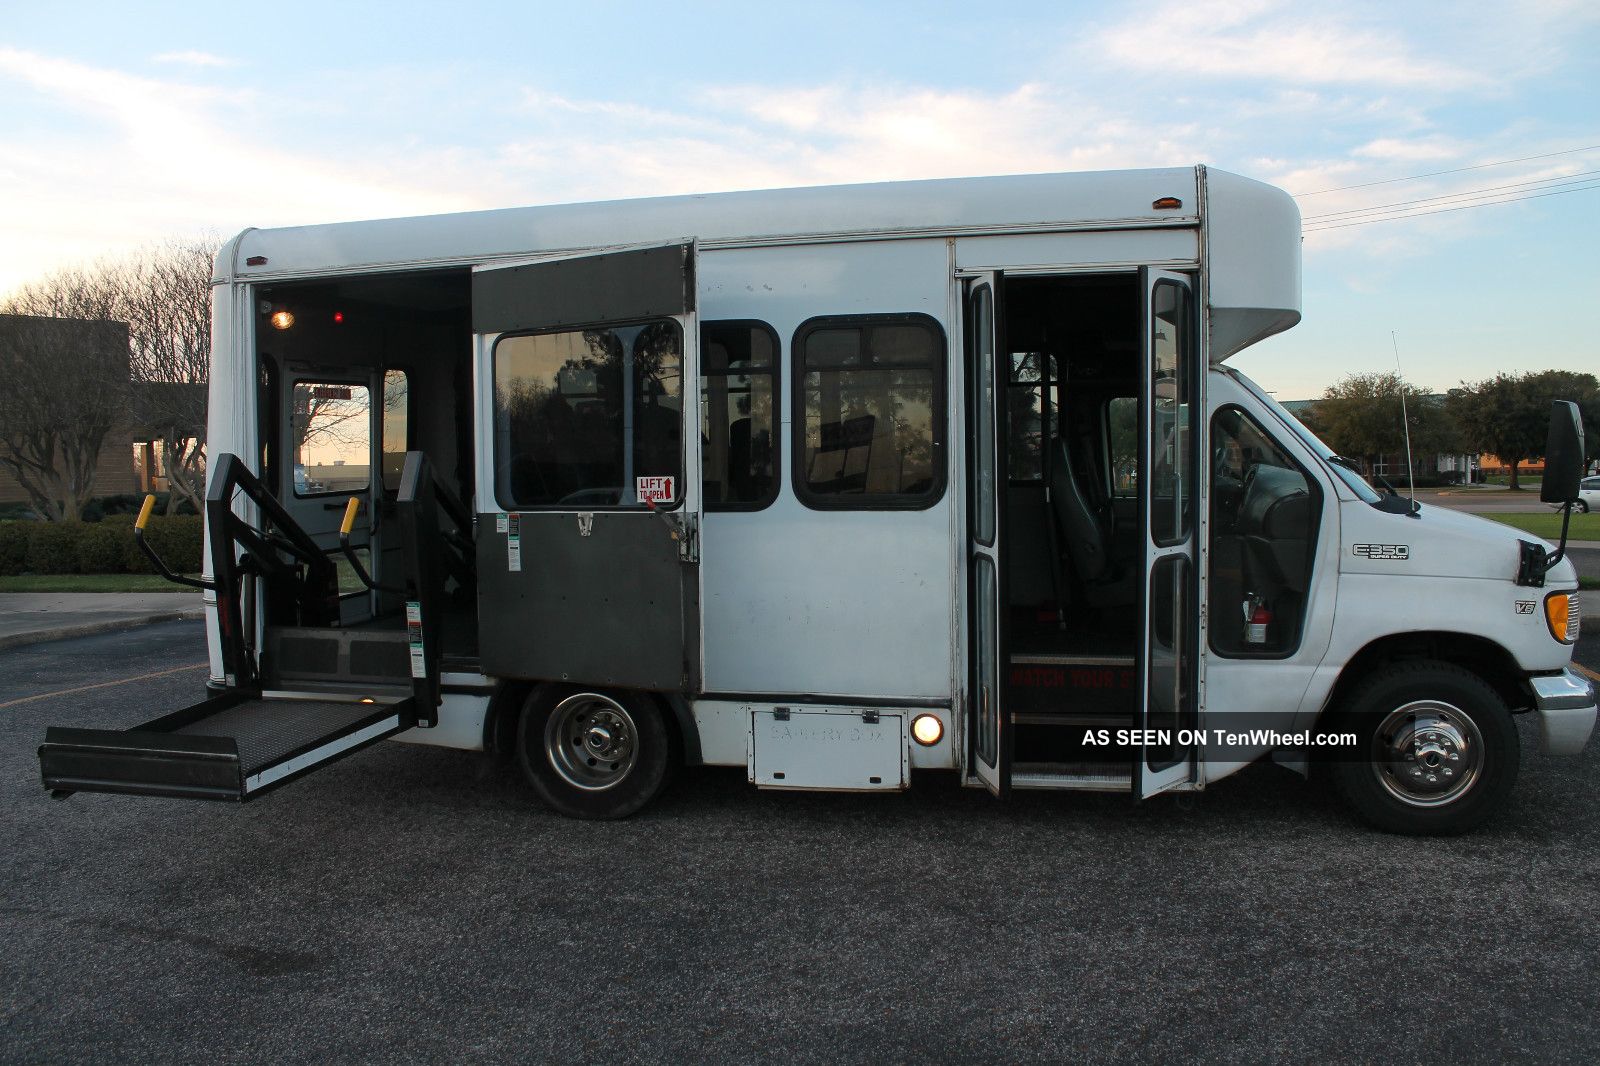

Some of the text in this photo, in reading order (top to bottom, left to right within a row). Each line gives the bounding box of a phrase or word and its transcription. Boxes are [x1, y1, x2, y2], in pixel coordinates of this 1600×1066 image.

[640, 478, 663, 488] LIFT
[639, 490, 664, 499] TO OPEN
[1072, 671, 1115, 689] YOUR
